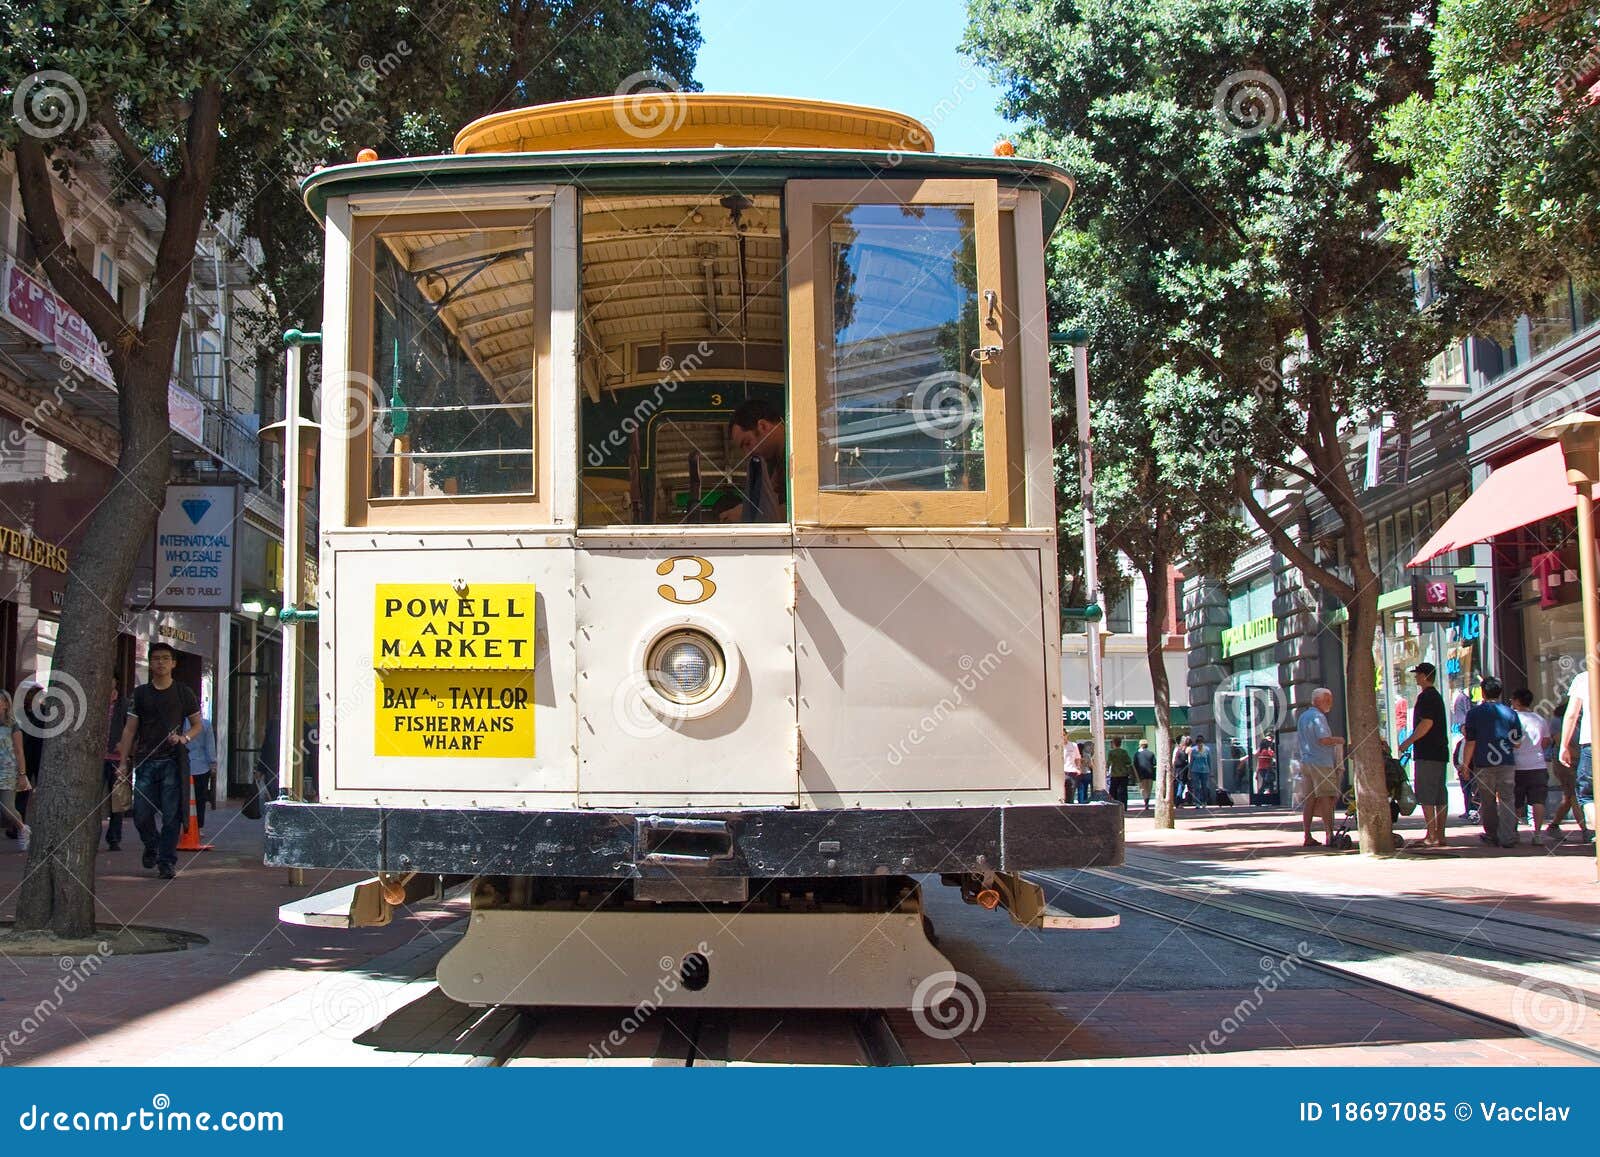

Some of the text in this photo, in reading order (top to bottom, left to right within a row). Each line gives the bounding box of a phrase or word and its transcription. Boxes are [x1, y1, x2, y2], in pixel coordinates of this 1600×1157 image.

[711, 394, 722, 406] 3
[160, 535, 230, 548] INTERNATIONAL
[166, 550, 222, 563] WHOLESALE
[169, 566, 218, 578] JEWELERS
[656, 555, 717, 605] 3
[165, 587, 222, 596] OPEN TO PUBLIC
[385, 598, 525, 618] POWELL
[421, 621, 490, 636] AND
[381, 638, 528, 658] MARKET
[382, 687, 420, 711] BAY
[450, 687, 529, 710] TAYLOR
[1103, 710, 1134, 721] SHOP
[394, 716, 515, 732] FISHERMANS
[423, 735, 485, 750] WHARF
